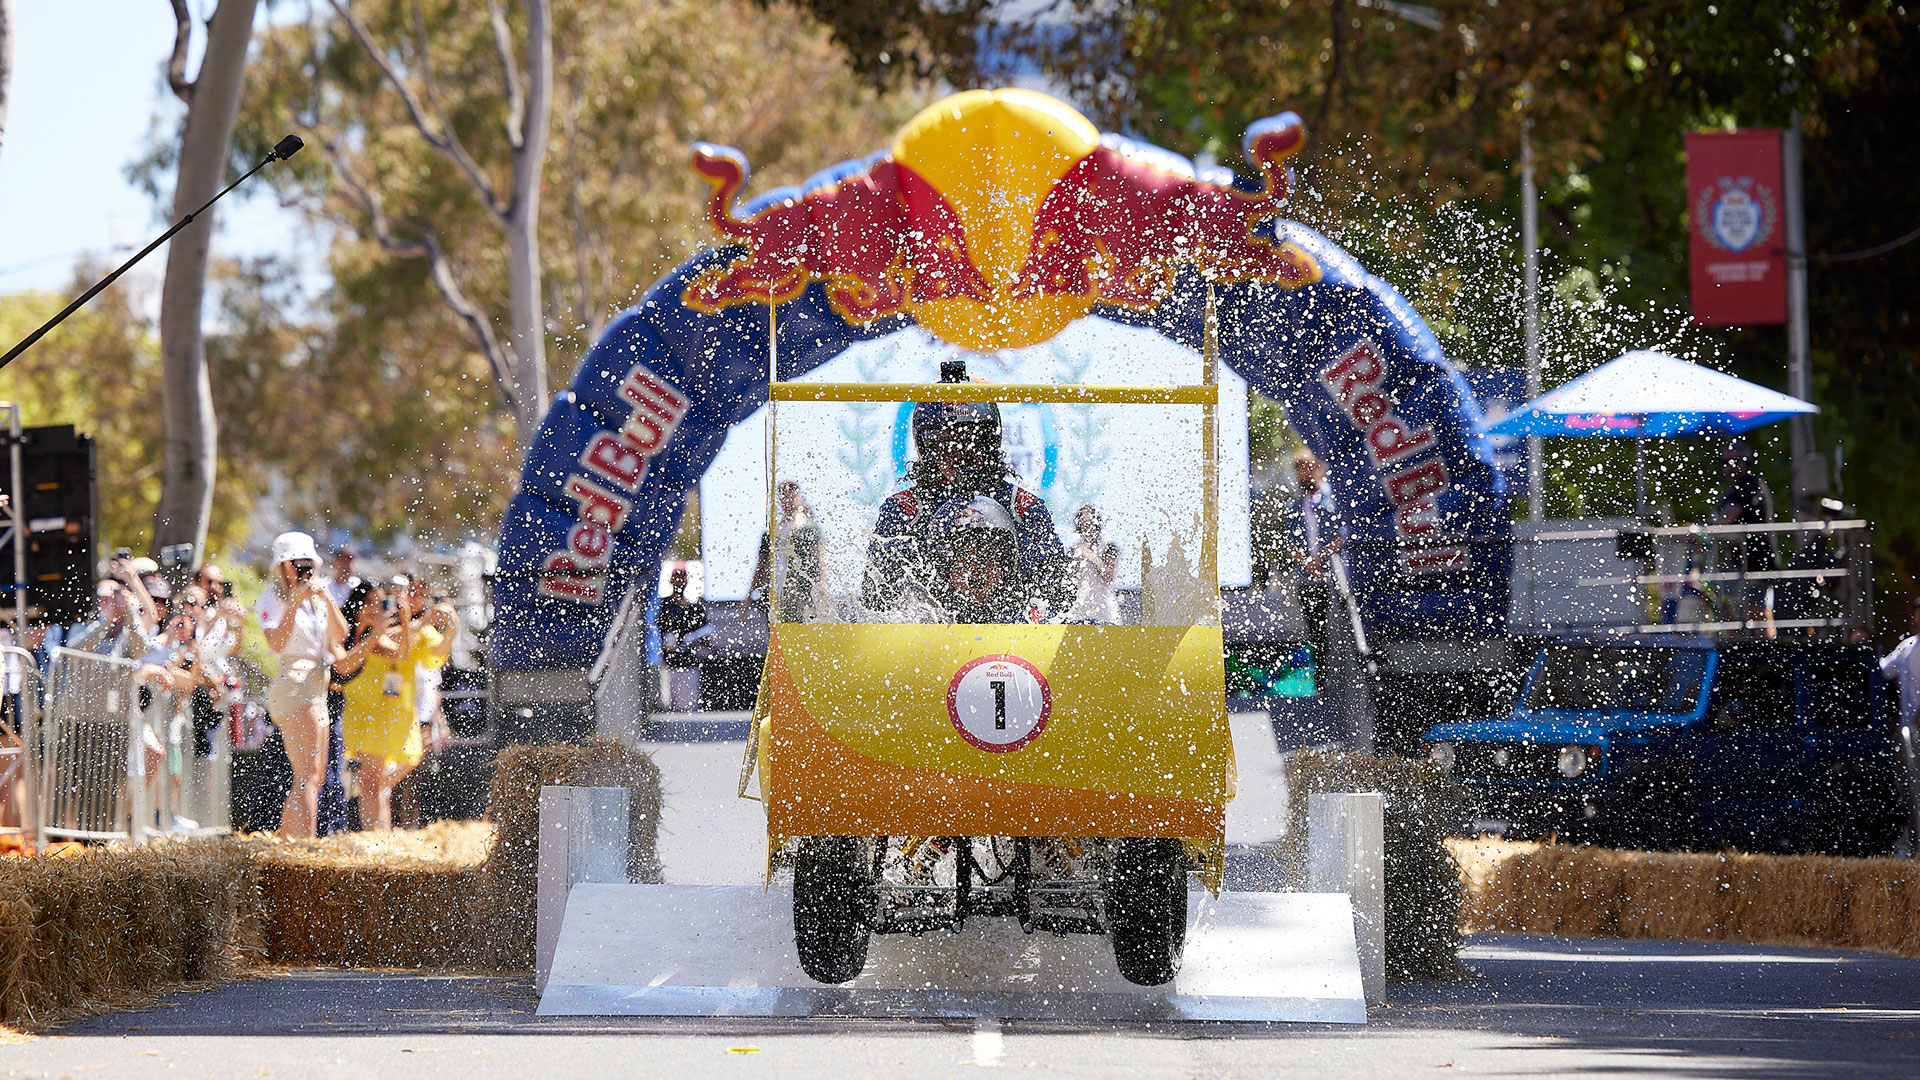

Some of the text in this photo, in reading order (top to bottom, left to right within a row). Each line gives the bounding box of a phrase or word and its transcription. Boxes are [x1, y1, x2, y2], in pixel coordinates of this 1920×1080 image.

[1321, 340, 1436, 465] Red
[540, 367, 687, 603] Red Bull
[989, 680, 1006, 730] 1
